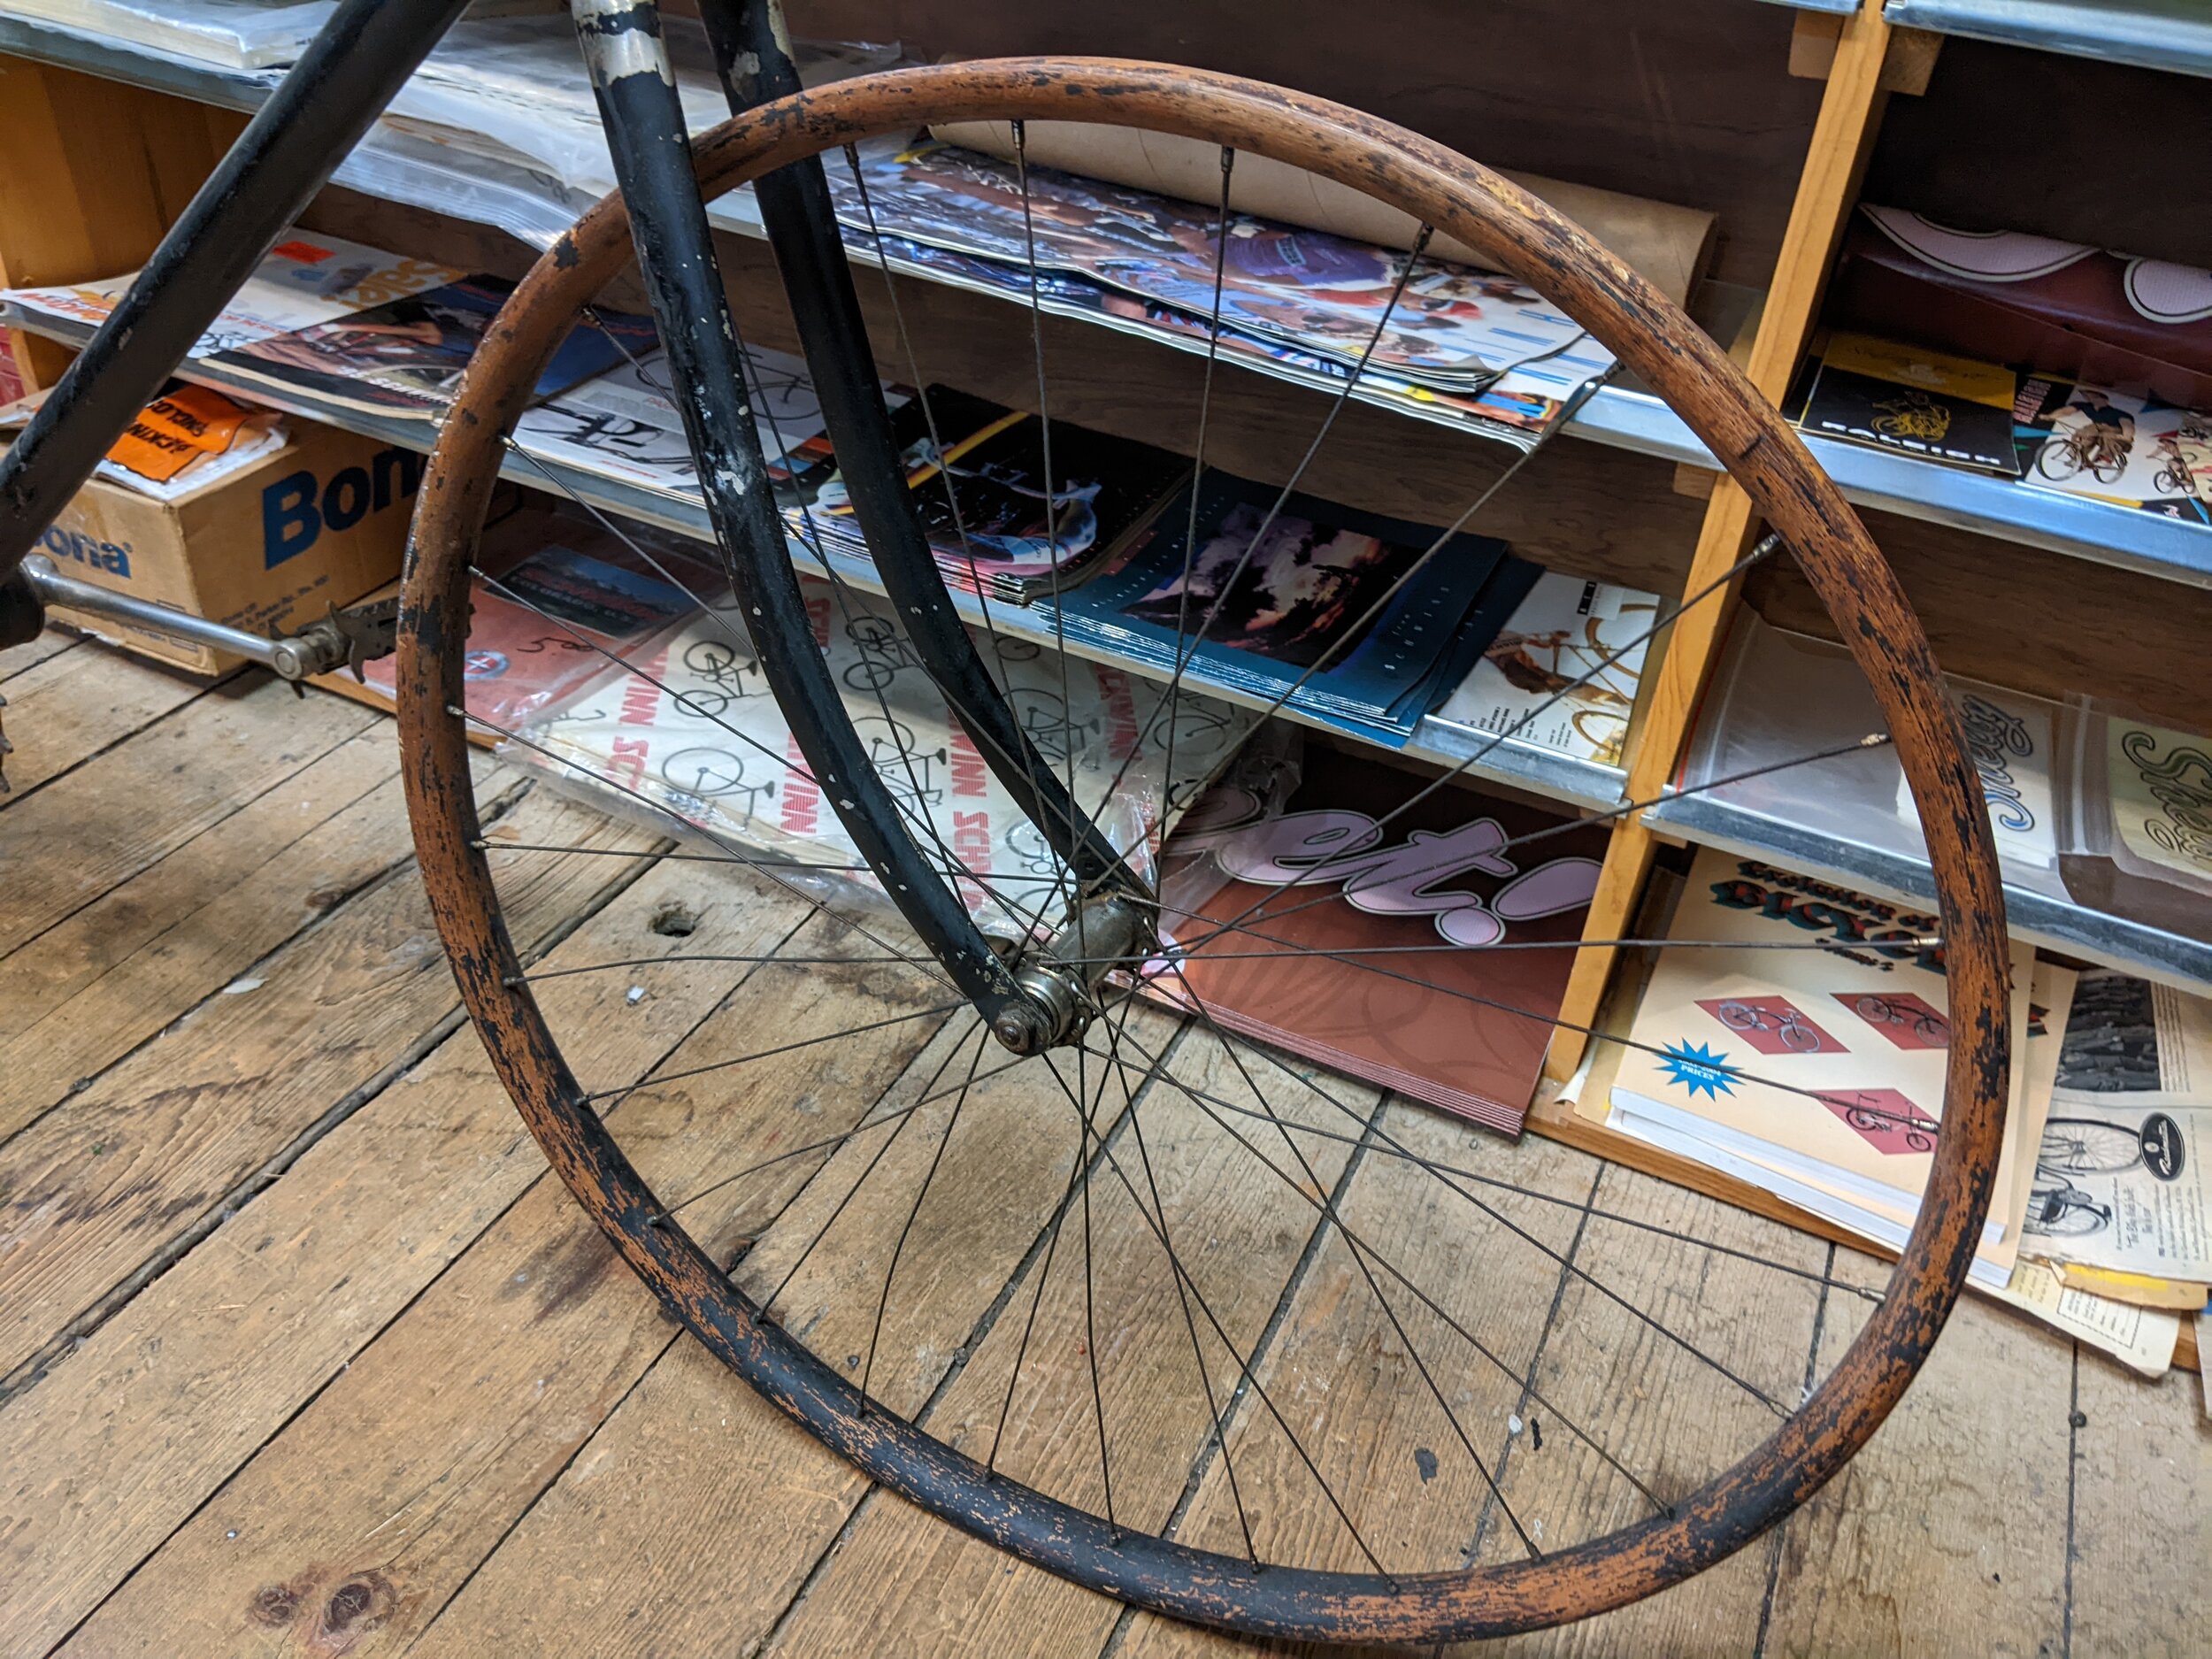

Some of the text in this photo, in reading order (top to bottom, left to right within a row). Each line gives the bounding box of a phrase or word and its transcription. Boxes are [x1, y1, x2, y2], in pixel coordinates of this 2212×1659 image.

[127, 423, 196, 453] PACKIN
[262, 446, 419, 572] Bon
[35, 524, 133, 580] ona
[2122, 732, 2212, 862] Shel
[1680, 1064, 1715, 1081] PRICES
